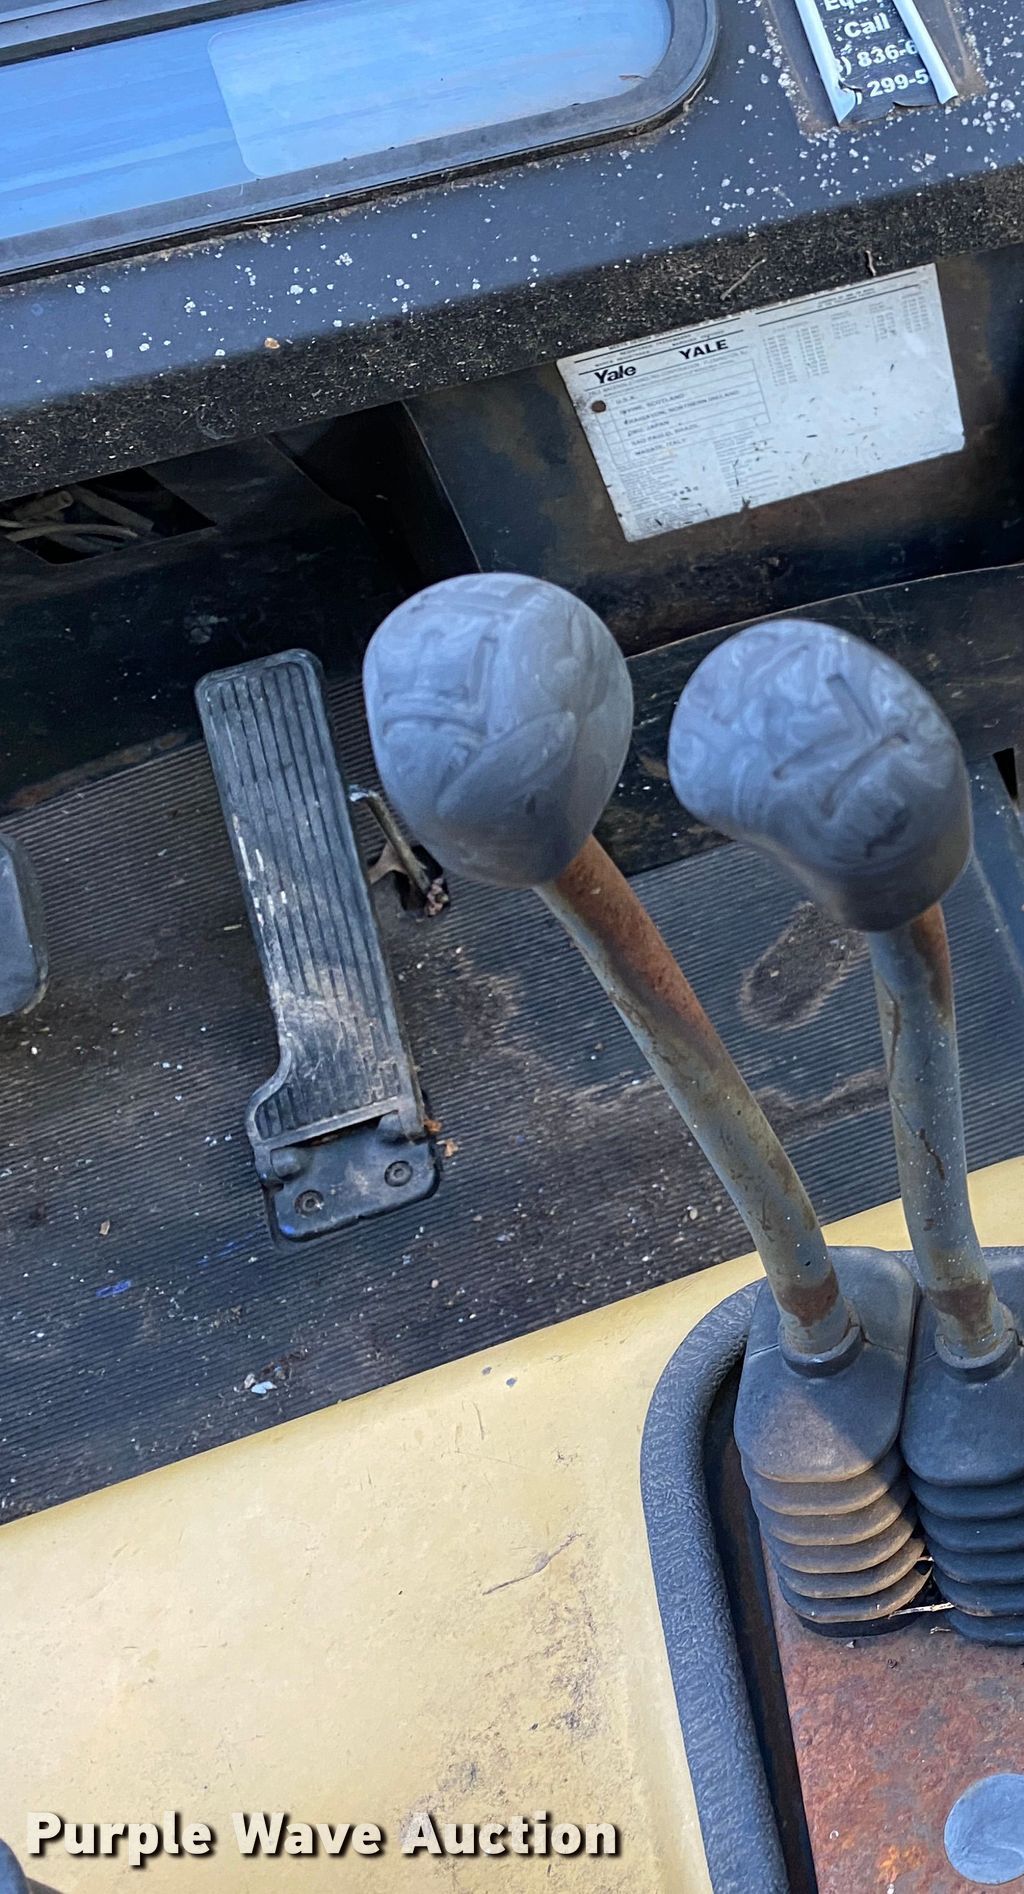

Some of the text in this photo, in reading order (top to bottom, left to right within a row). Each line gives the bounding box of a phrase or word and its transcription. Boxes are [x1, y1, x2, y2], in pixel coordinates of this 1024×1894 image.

[844, 12, 891, 38] Call
[866, 68, 929, 98] 299-5
[679, 339, 729, 360] YALE
[594, 365, 637, 384] Yale
